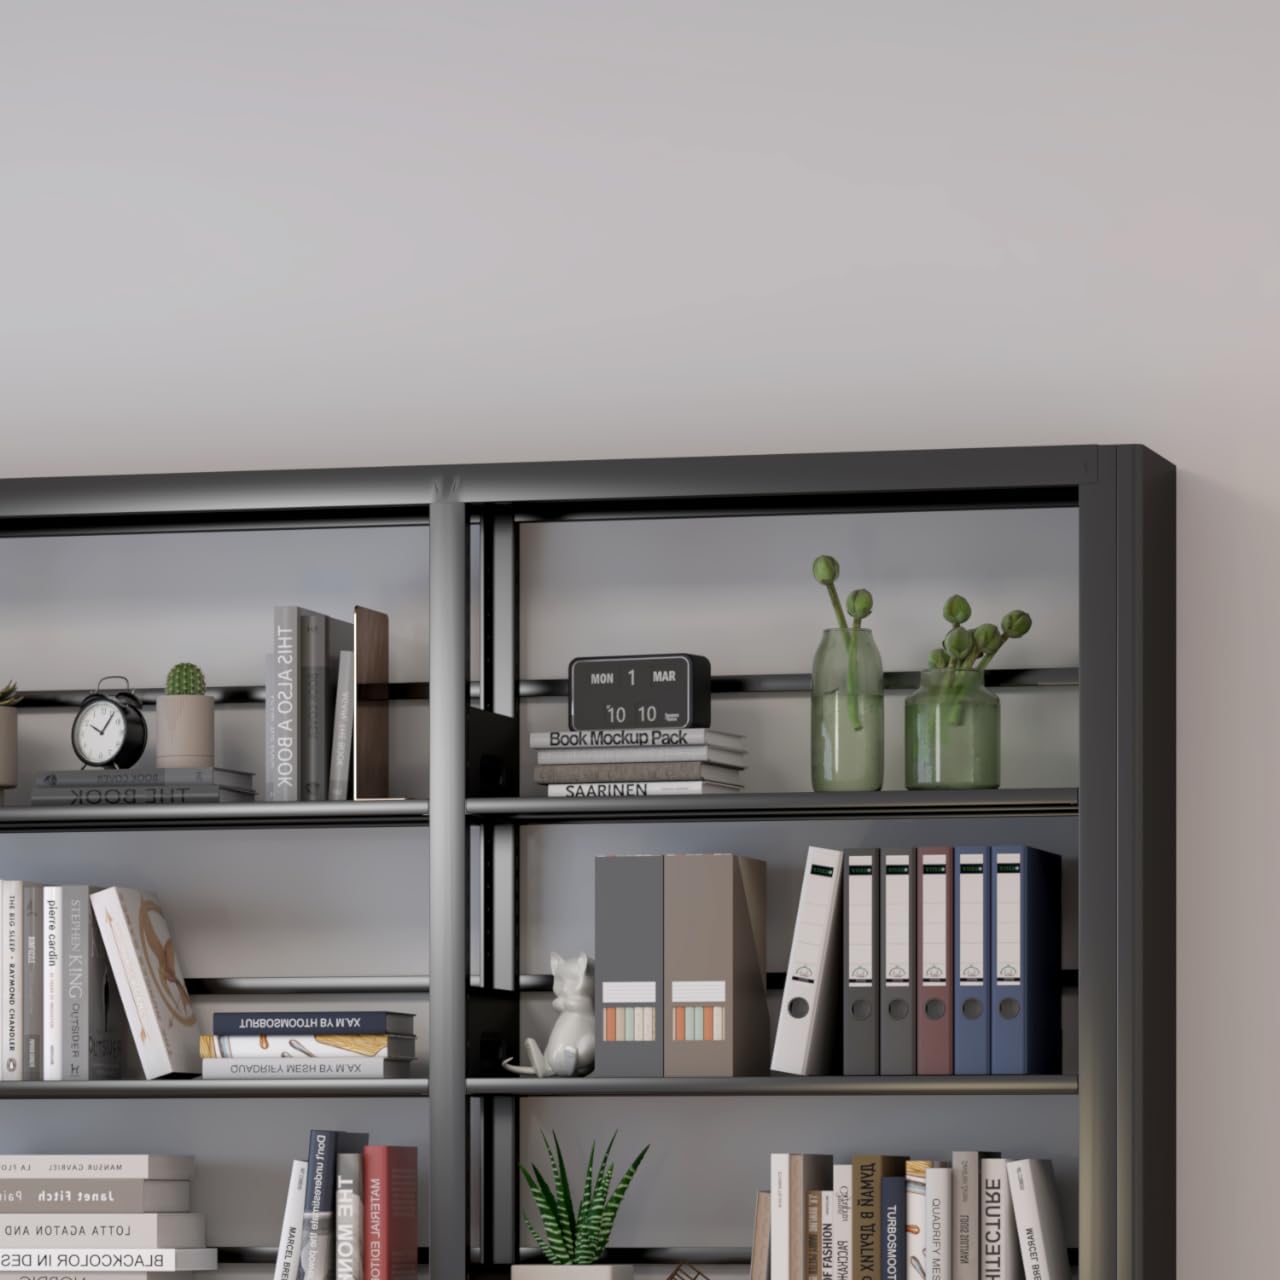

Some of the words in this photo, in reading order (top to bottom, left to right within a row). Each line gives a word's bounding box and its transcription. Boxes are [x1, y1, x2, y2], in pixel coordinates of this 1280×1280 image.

[591, 673, 614, 685] MON
[628, 669, 636, 686] 1
[652, 670, 676, 683] MAR
[607, 705, 626, 723] 10
[638, 705, 657, 723] 10
[549, 731, 587, 746] Book
[590, 730, 649, 746] Mockup
[651, 729, 688, 745] Pack
[565, 783, 648, 798] SAARINEN
[48, 900, 57, 931] pierre
[71, 899, 80, 953] STEPHEN
[48, 933, 57, 967] cardin
[69, 954, 82, 1000] KING
[71, 1003, 80, 1058] OUTSIDER
[284, 1226, 297, 1259] MARCEL
[931, 1198, 941, 1255] QUADRIFY
[822, 1223, 833, 1268] FASHION
